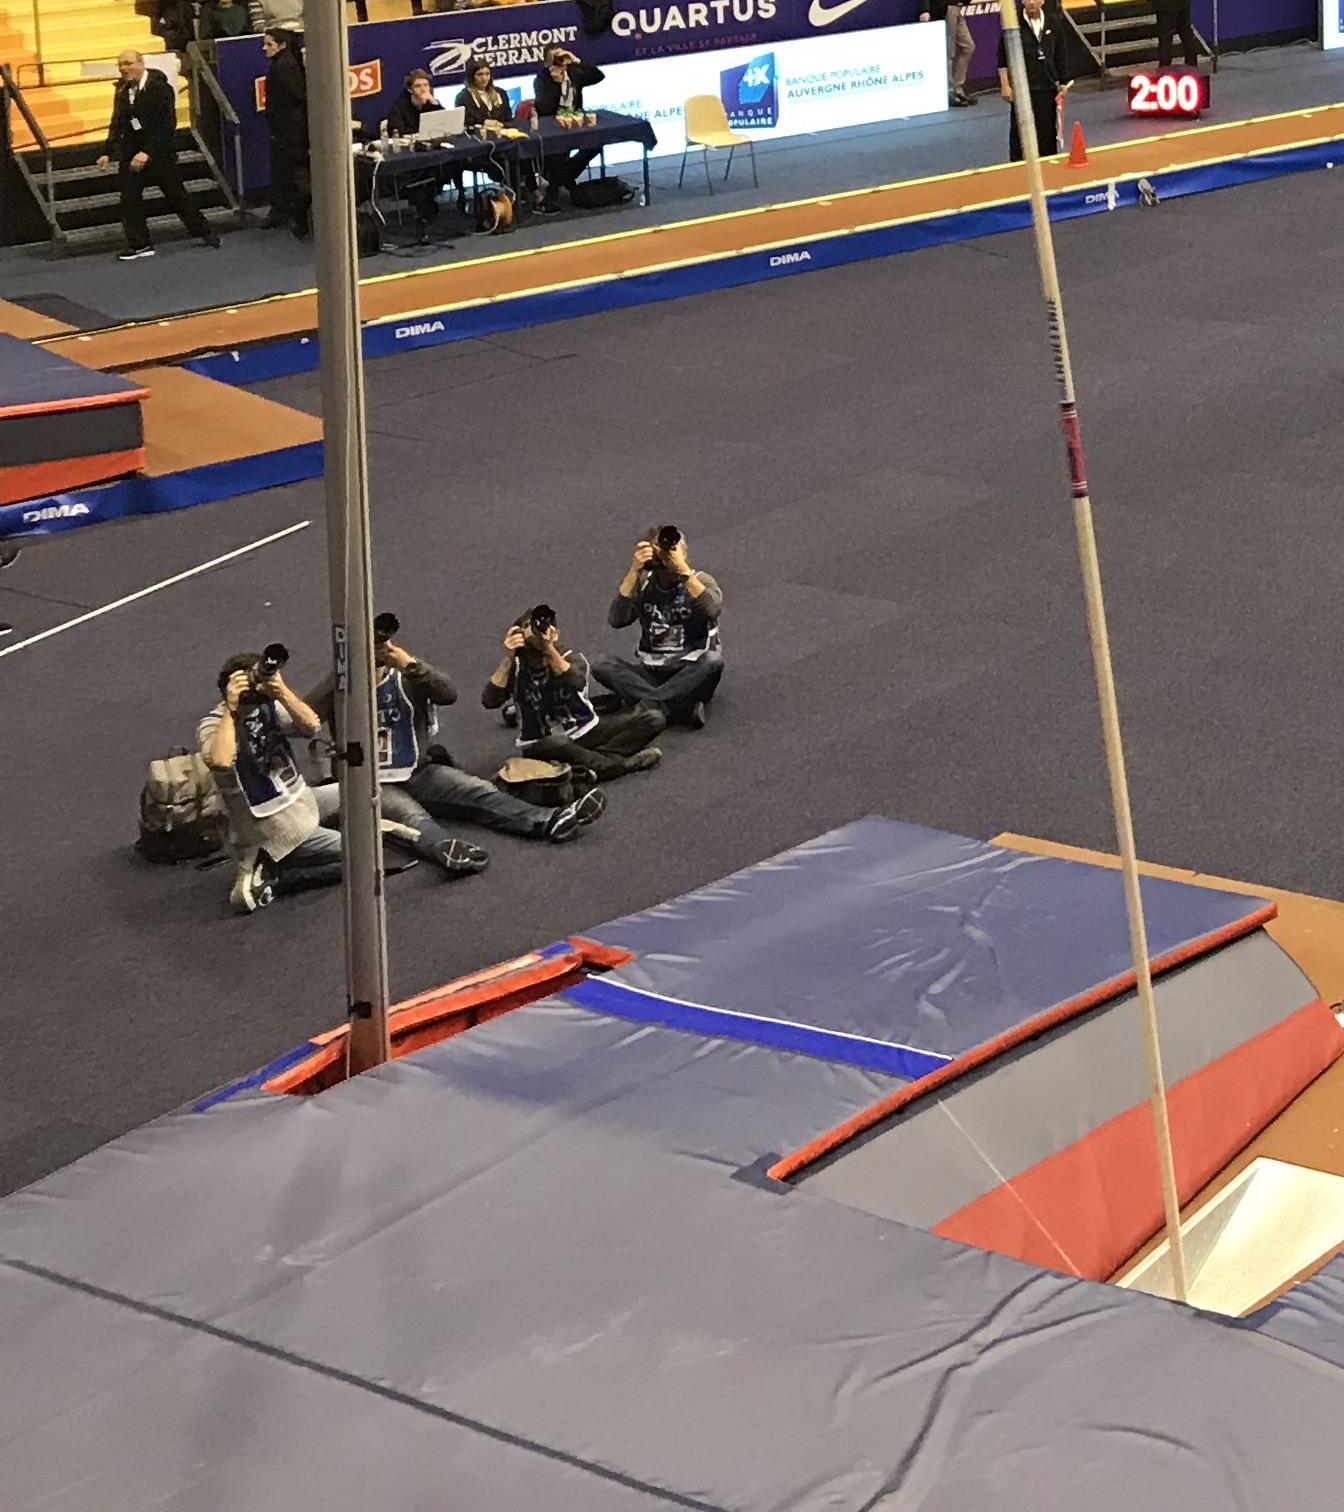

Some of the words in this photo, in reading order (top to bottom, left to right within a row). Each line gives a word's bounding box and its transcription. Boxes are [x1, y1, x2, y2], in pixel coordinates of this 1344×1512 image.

[473, 26, 578, 53] CLERMONT
[785, 73, 827, 86] BANQUE
[830, 64, 881, 82] POPULAIRE
[787, 82, 847, 98] AUVERGNE
[850, 75, 888, 90] RHÔNE
[891, 70, 924, 86] ALPES
[1130, 75, 1198, 110] 2:00
[654, 105, 683, 118] ALPE
[728, 106, 773, 118] ANQUE
[727, 117, 774, 128] OPULAIRE
[770, 251, 812, 267] DIMA
[395, 320, 445, 338] DIMA
[23, 503, 90, 523] DIMA
